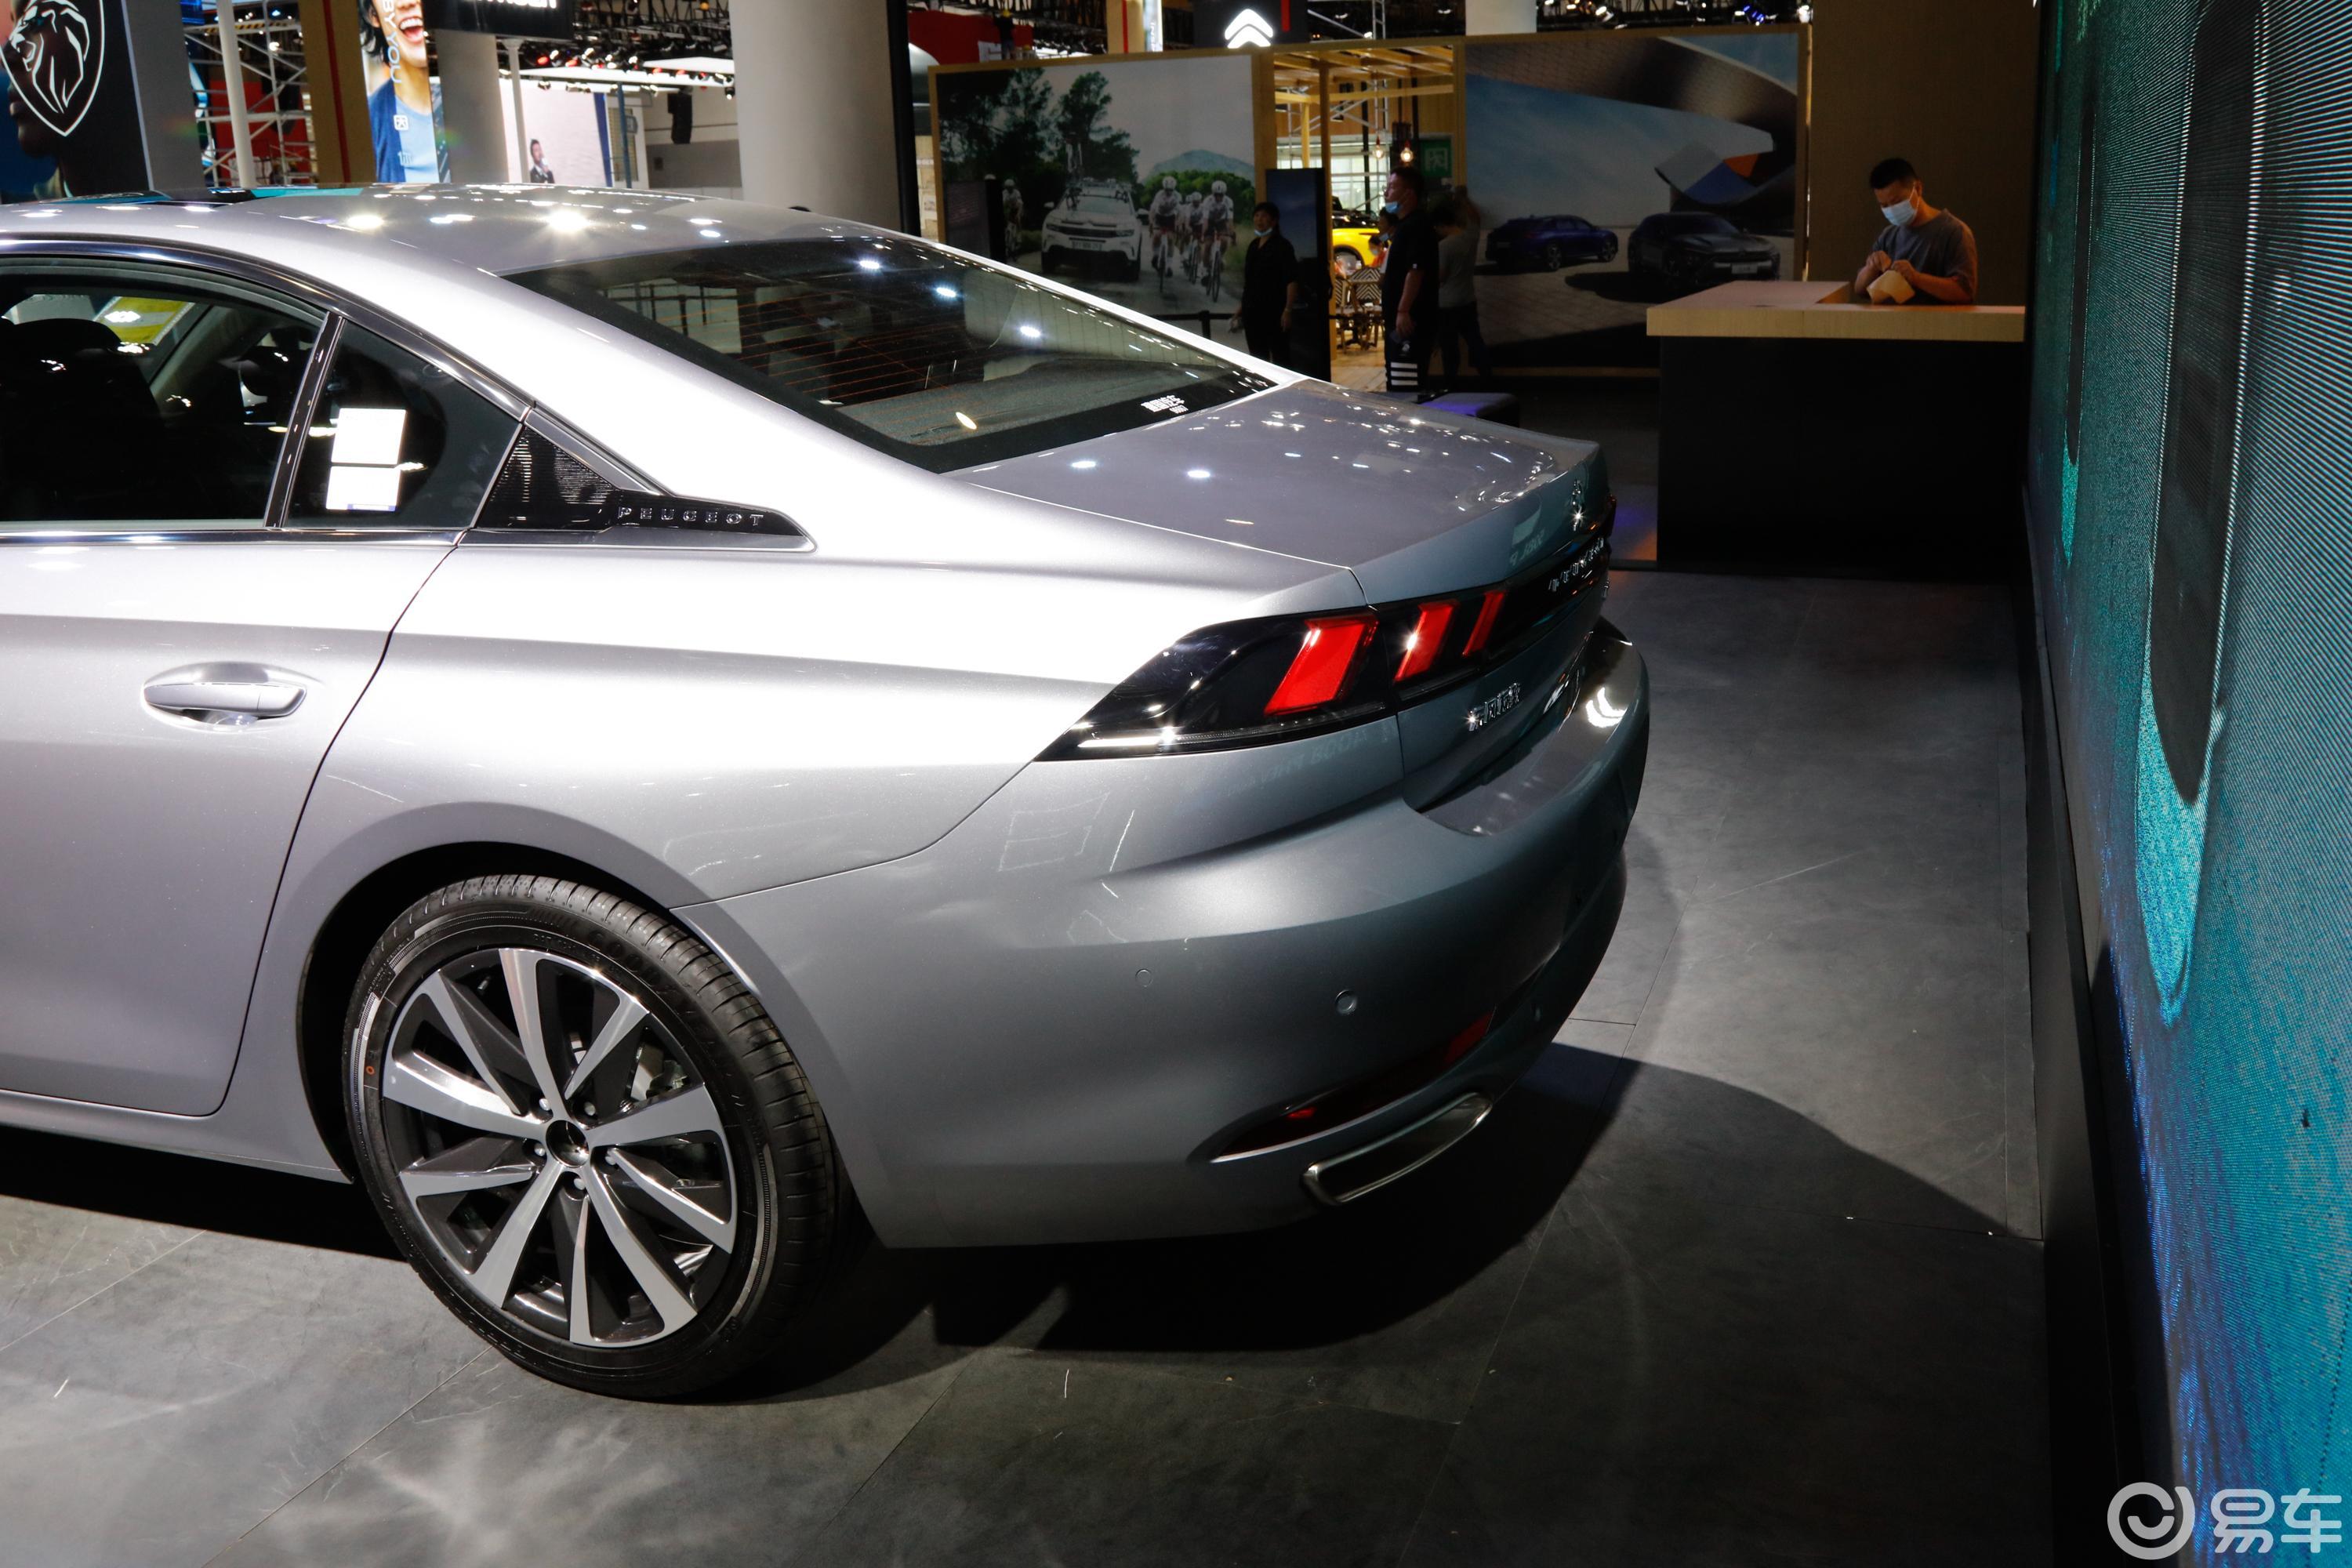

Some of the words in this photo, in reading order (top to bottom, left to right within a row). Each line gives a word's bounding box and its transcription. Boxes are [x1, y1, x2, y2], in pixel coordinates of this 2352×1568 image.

[383, 0, 397, 28] BY
[387, 31, 402, 83] YOU
[618, 506, 764, 526] PEUGEOT
